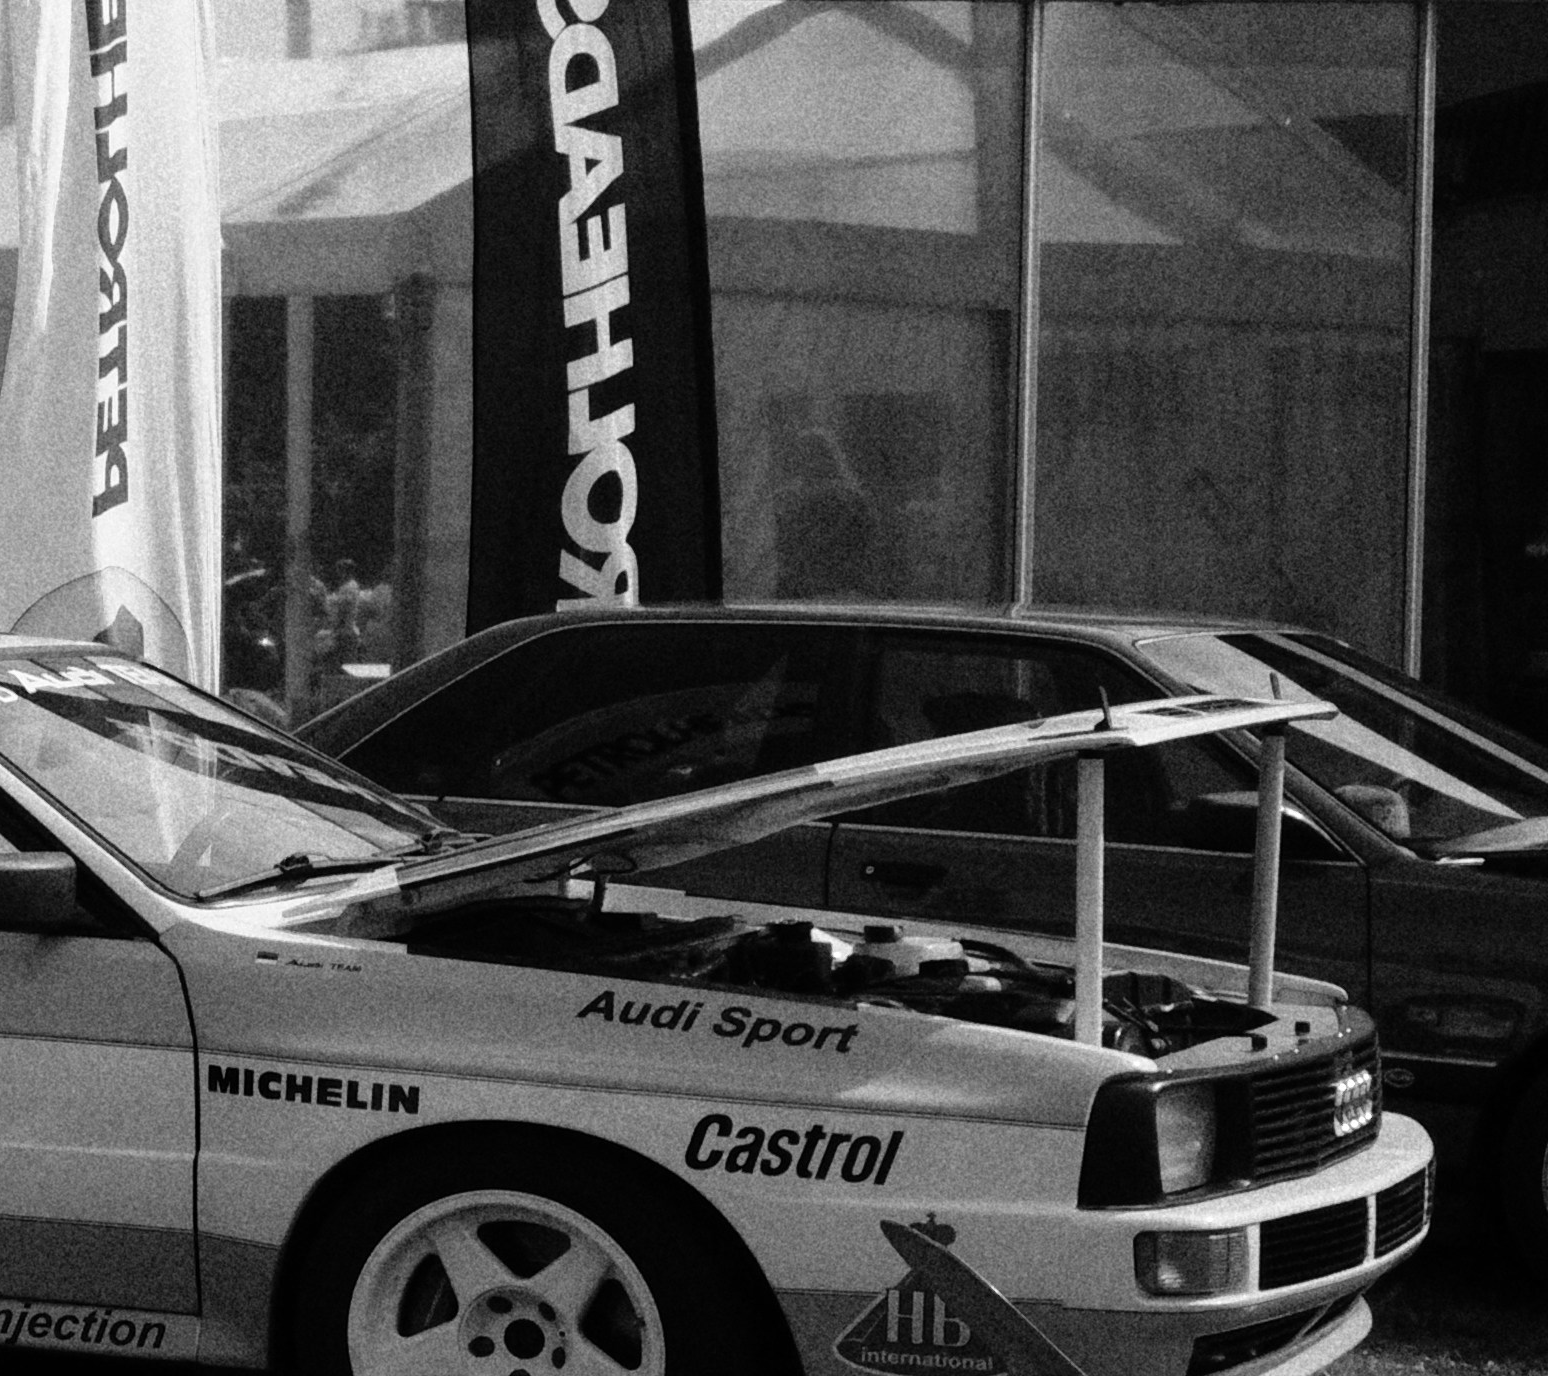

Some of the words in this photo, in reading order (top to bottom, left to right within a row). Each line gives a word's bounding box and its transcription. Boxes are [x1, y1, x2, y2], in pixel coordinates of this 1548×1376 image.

[575, 990, 704, 1032] Audi
[712, 1005, 858, 1054] Sport
[206, 1064, 421, 1115] MICHELIN
[684, 1113, 905, 1186] Castrol
[860, 1346, 994, 1371] international
